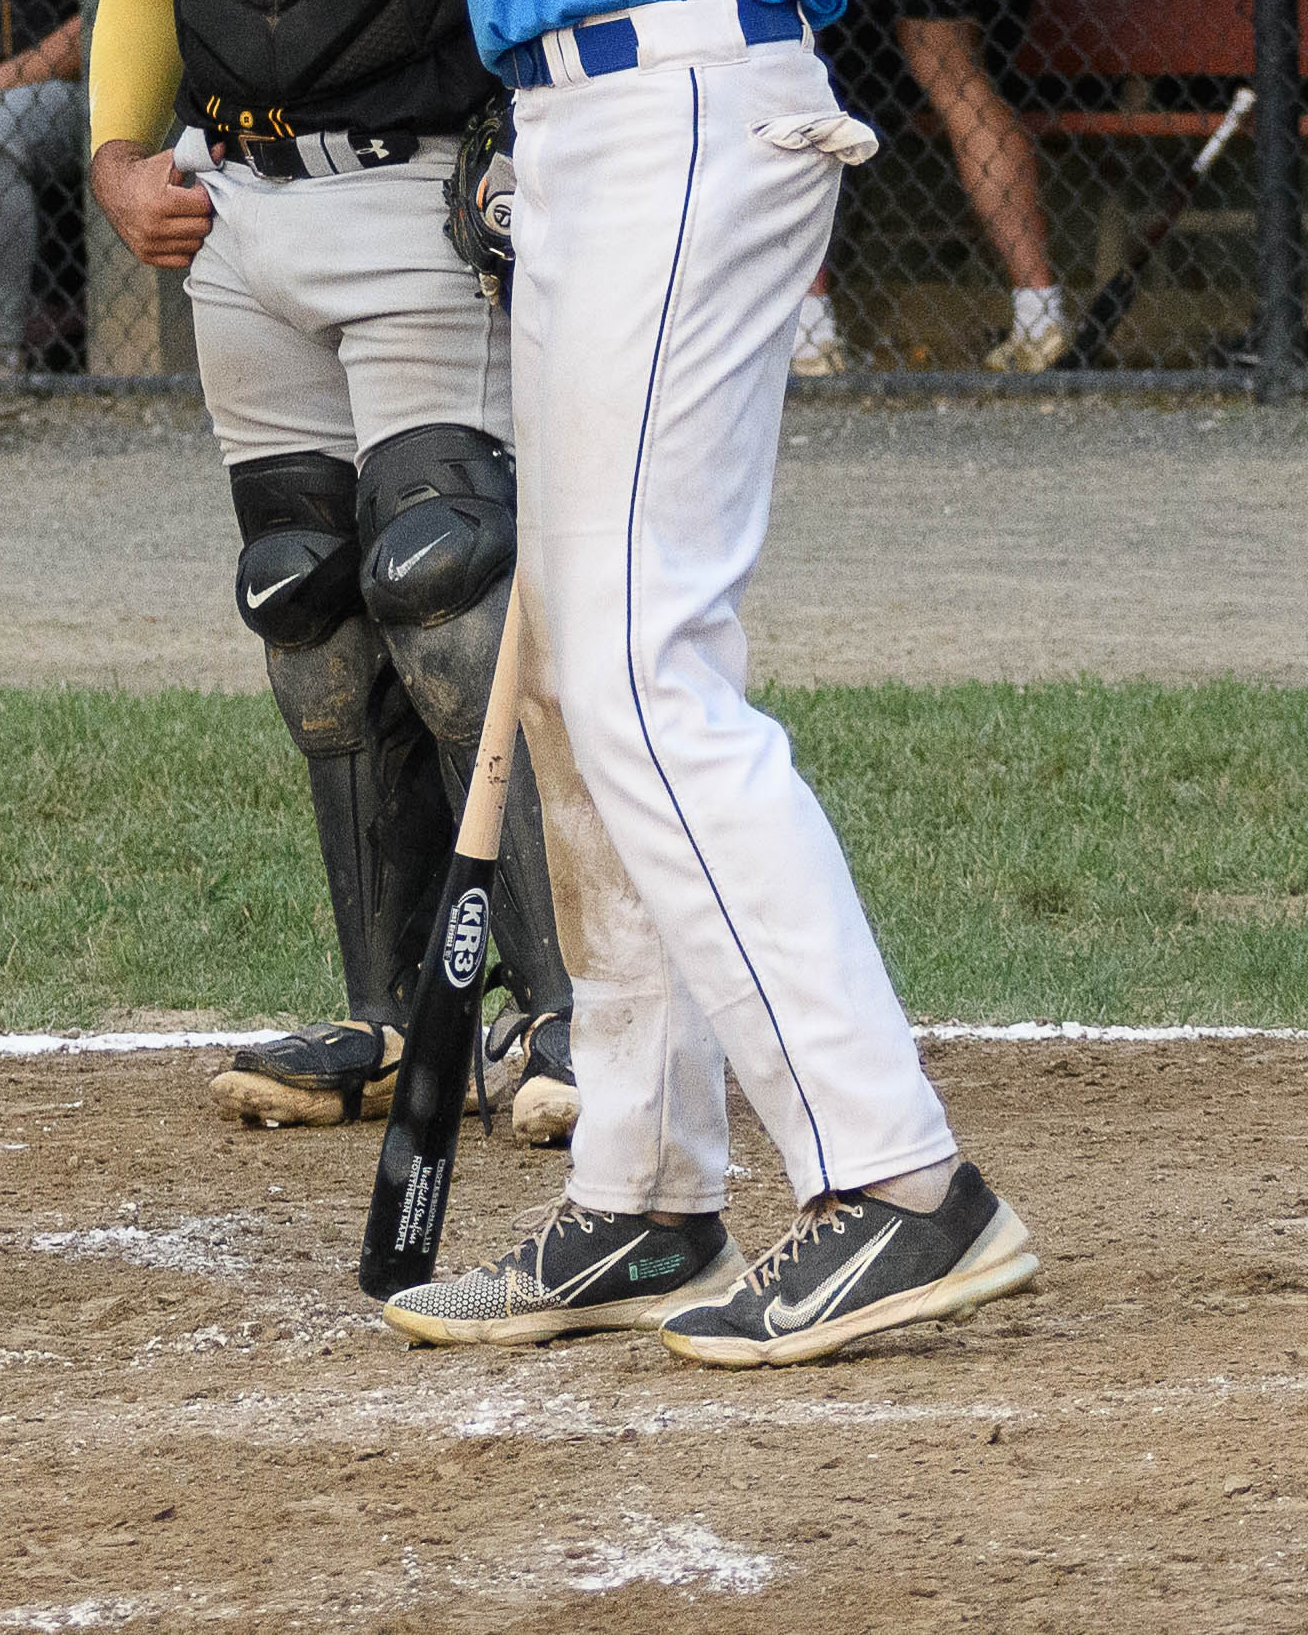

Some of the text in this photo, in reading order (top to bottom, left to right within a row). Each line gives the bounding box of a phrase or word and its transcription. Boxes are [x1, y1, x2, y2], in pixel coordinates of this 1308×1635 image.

[454, 902, 483, 972] KR3
[395, 1155, 423, 1253] NORTHERN MAPLE
[416, 1166, 434, 1207] Westfield
